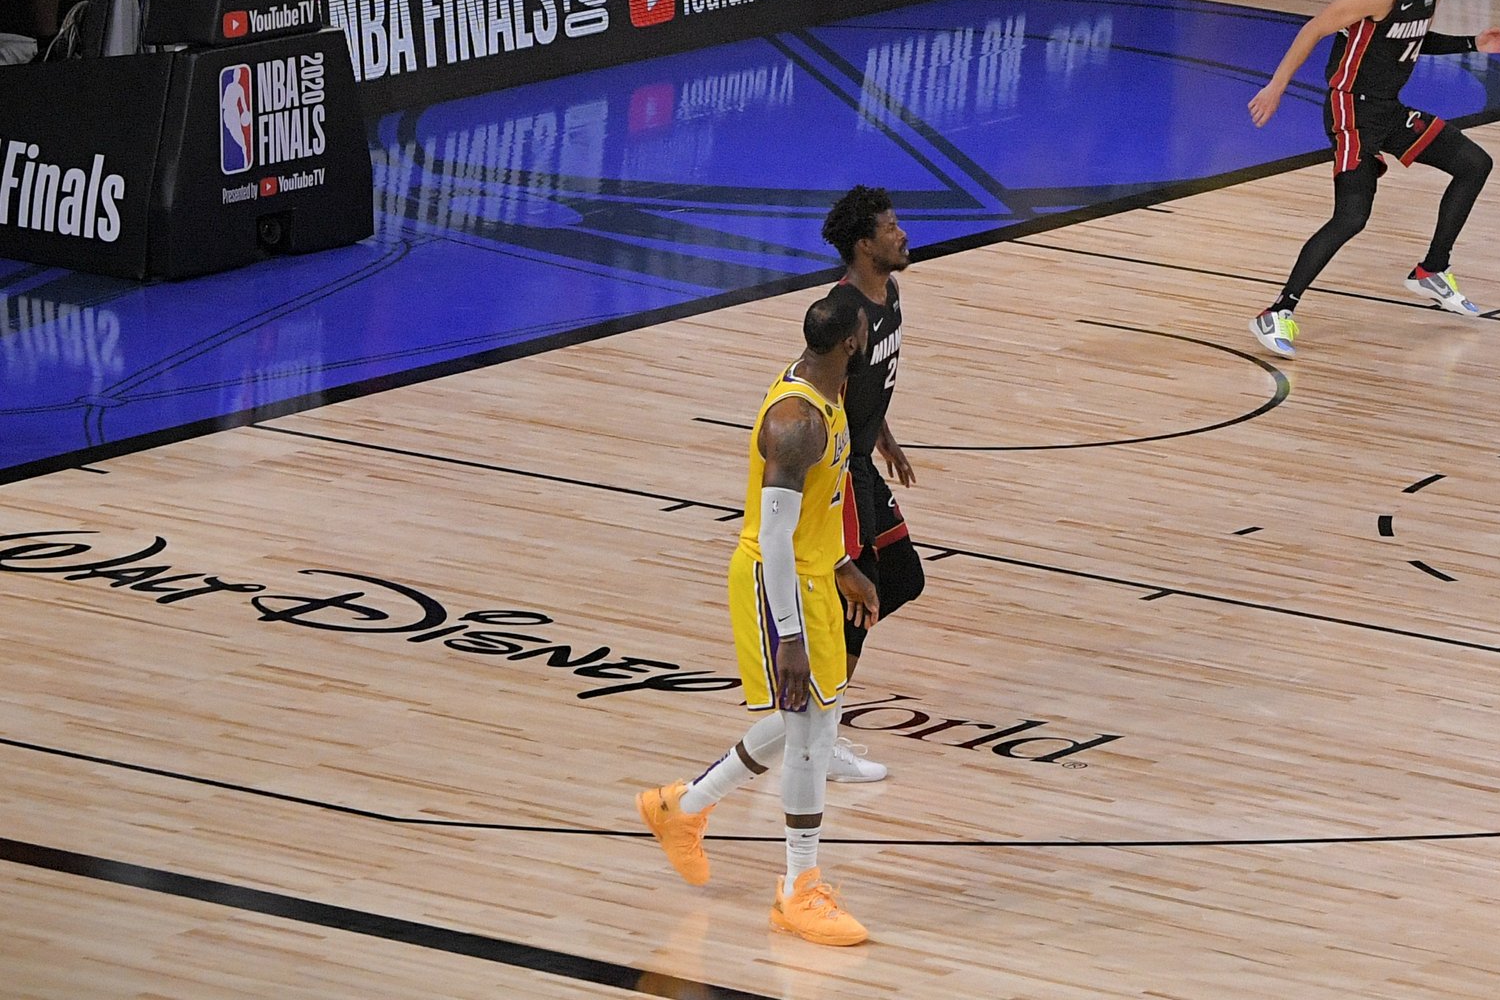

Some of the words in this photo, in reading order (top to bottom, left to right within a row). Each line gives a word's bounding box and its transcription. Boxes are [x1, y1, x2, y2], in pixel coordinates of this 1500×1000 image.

[1385, 19, 1429, 39] MIAM
[257, 56, 299, 113] NBA
[300, 52, 325, 105] 2020
[258, 104, 325, 166] FINALS
[222, 180, 249, 205] Presented
[870, 325, 902, 366] MIAM
